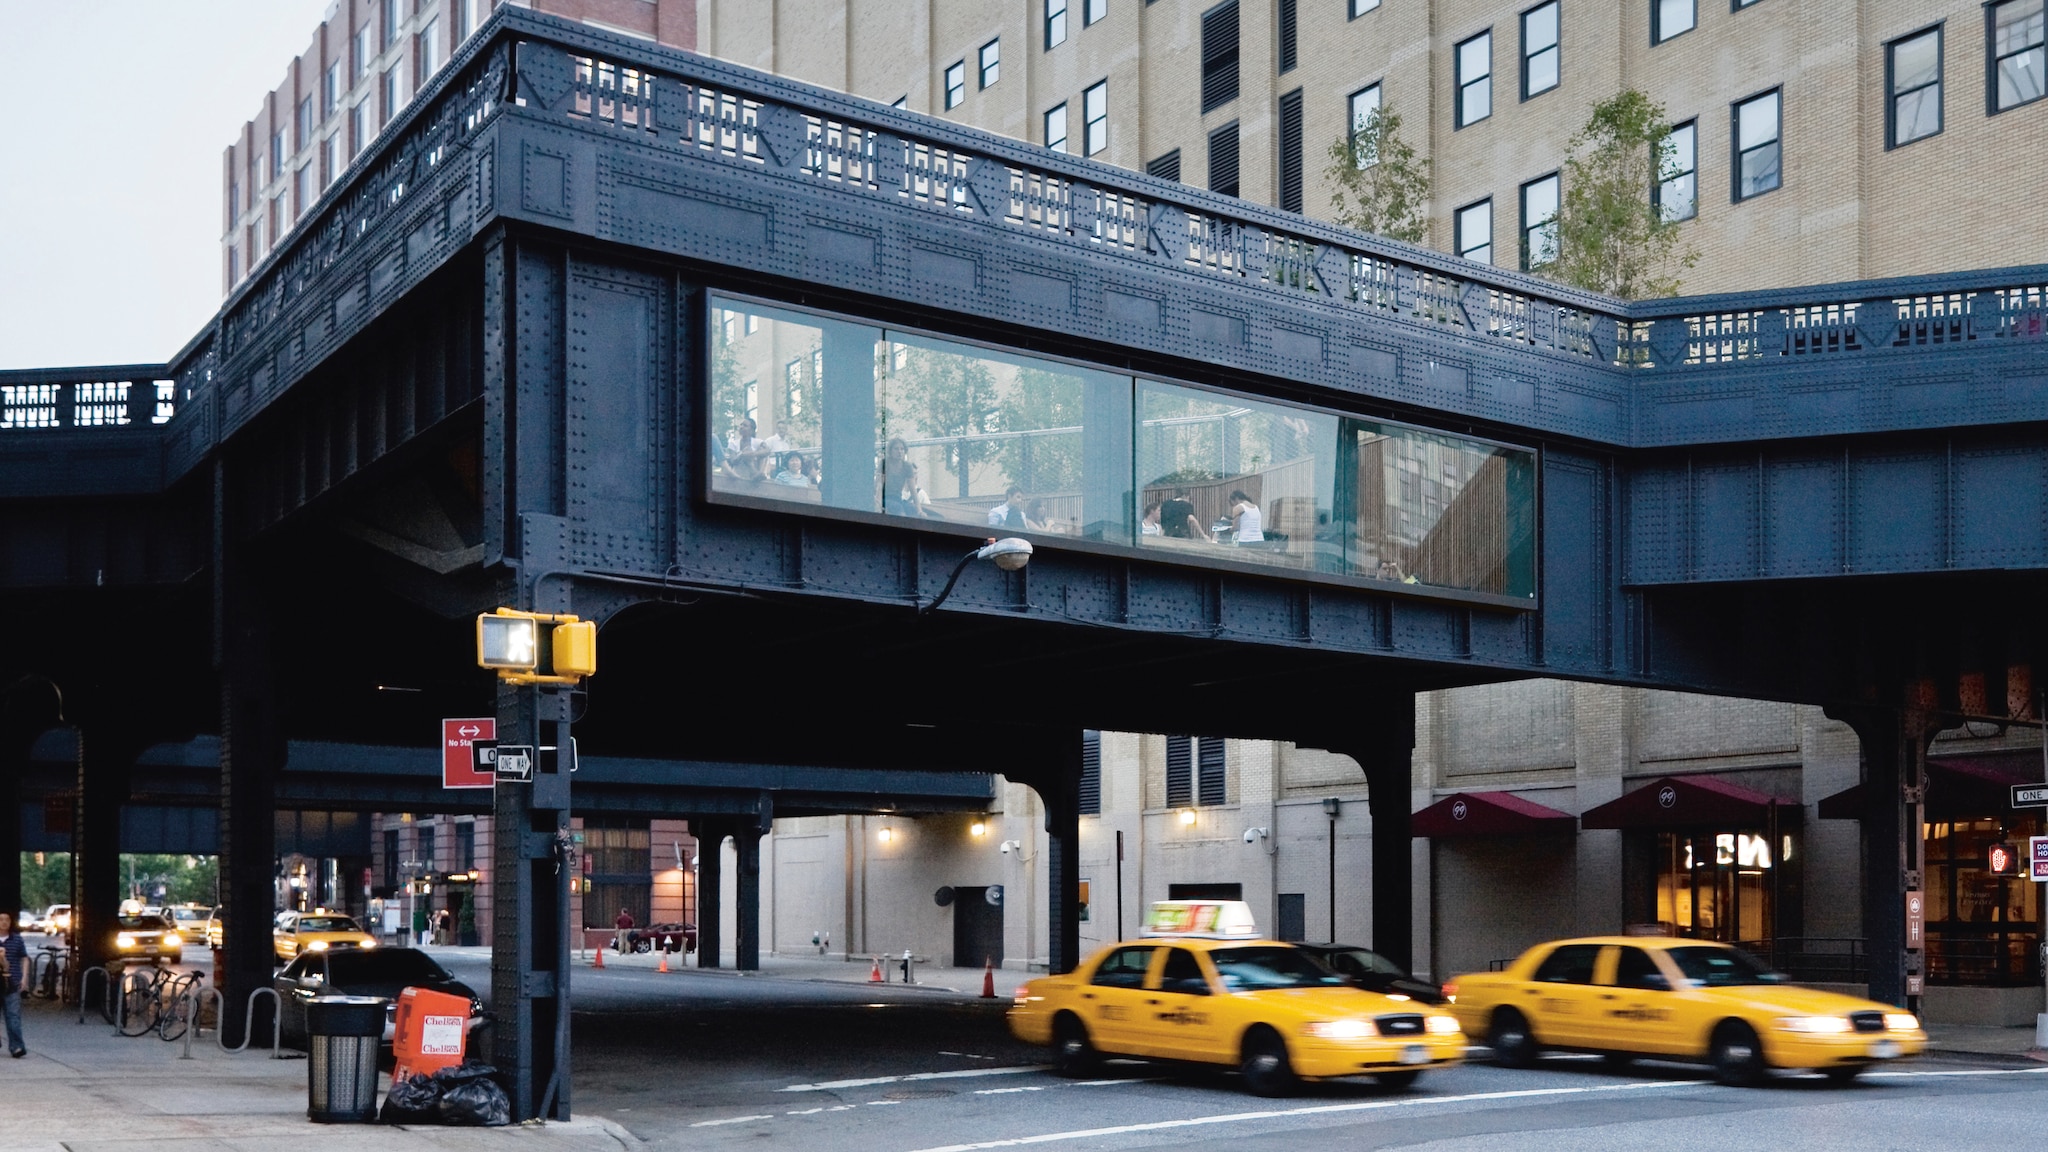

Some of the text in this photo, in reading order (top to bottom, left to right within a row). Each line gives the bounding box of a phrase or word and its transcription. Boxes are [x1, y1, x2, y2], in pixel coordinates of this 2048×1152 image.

[448, 739, 459, 747] No
[500, 756, 528, 770] ONE WAY
[2022, 790, 2043, 800] ONE
